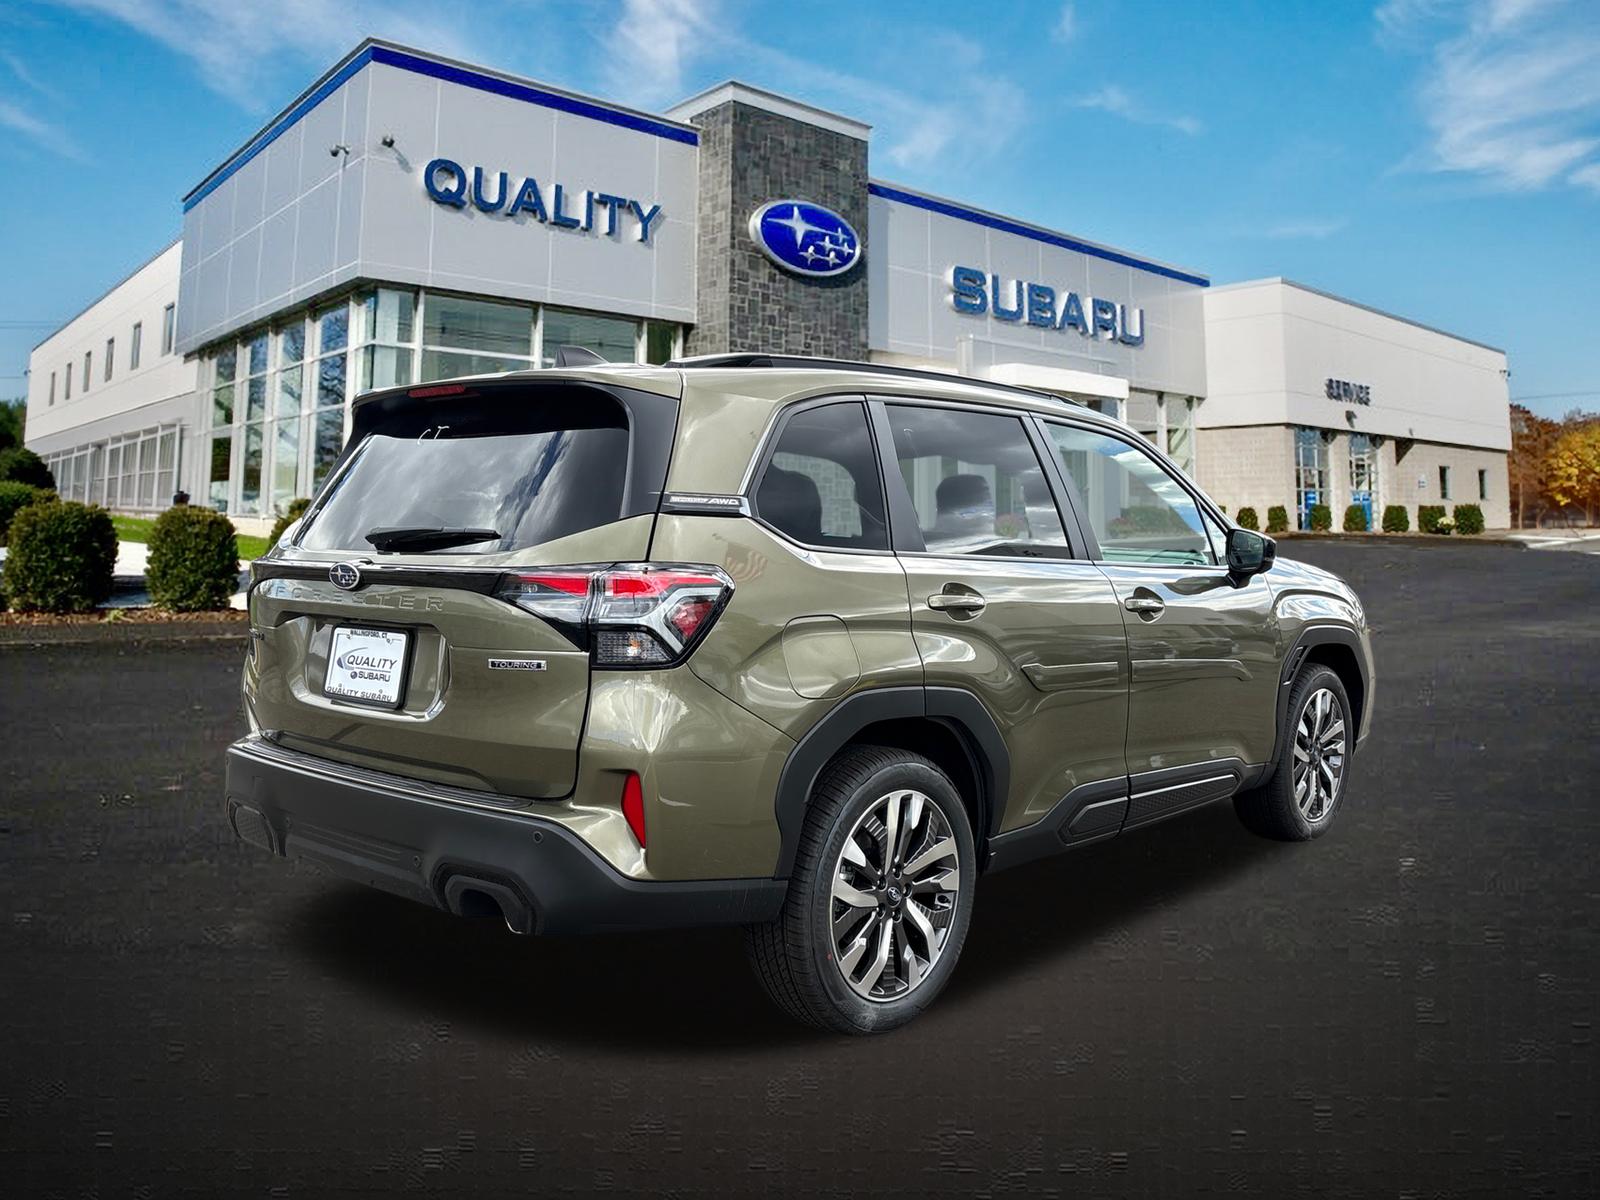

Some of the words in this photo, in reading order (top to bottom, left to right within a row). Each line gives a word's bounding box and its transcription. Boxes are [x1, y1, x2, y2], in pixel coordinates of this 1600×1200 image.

[424, 158, 661, 242] QUALITY
[948, 265, 1144, 346] SUBARU
[708, 497, 740, 506] AWD
[347, 655, 397, 669] QUALITY
[494, 660, 538, 669] TOURING
[358, 671, 390, 682] SUBARU
[327, 686, 358, 695] QUALITY
[360, 691, 392, 701] SUBARU
